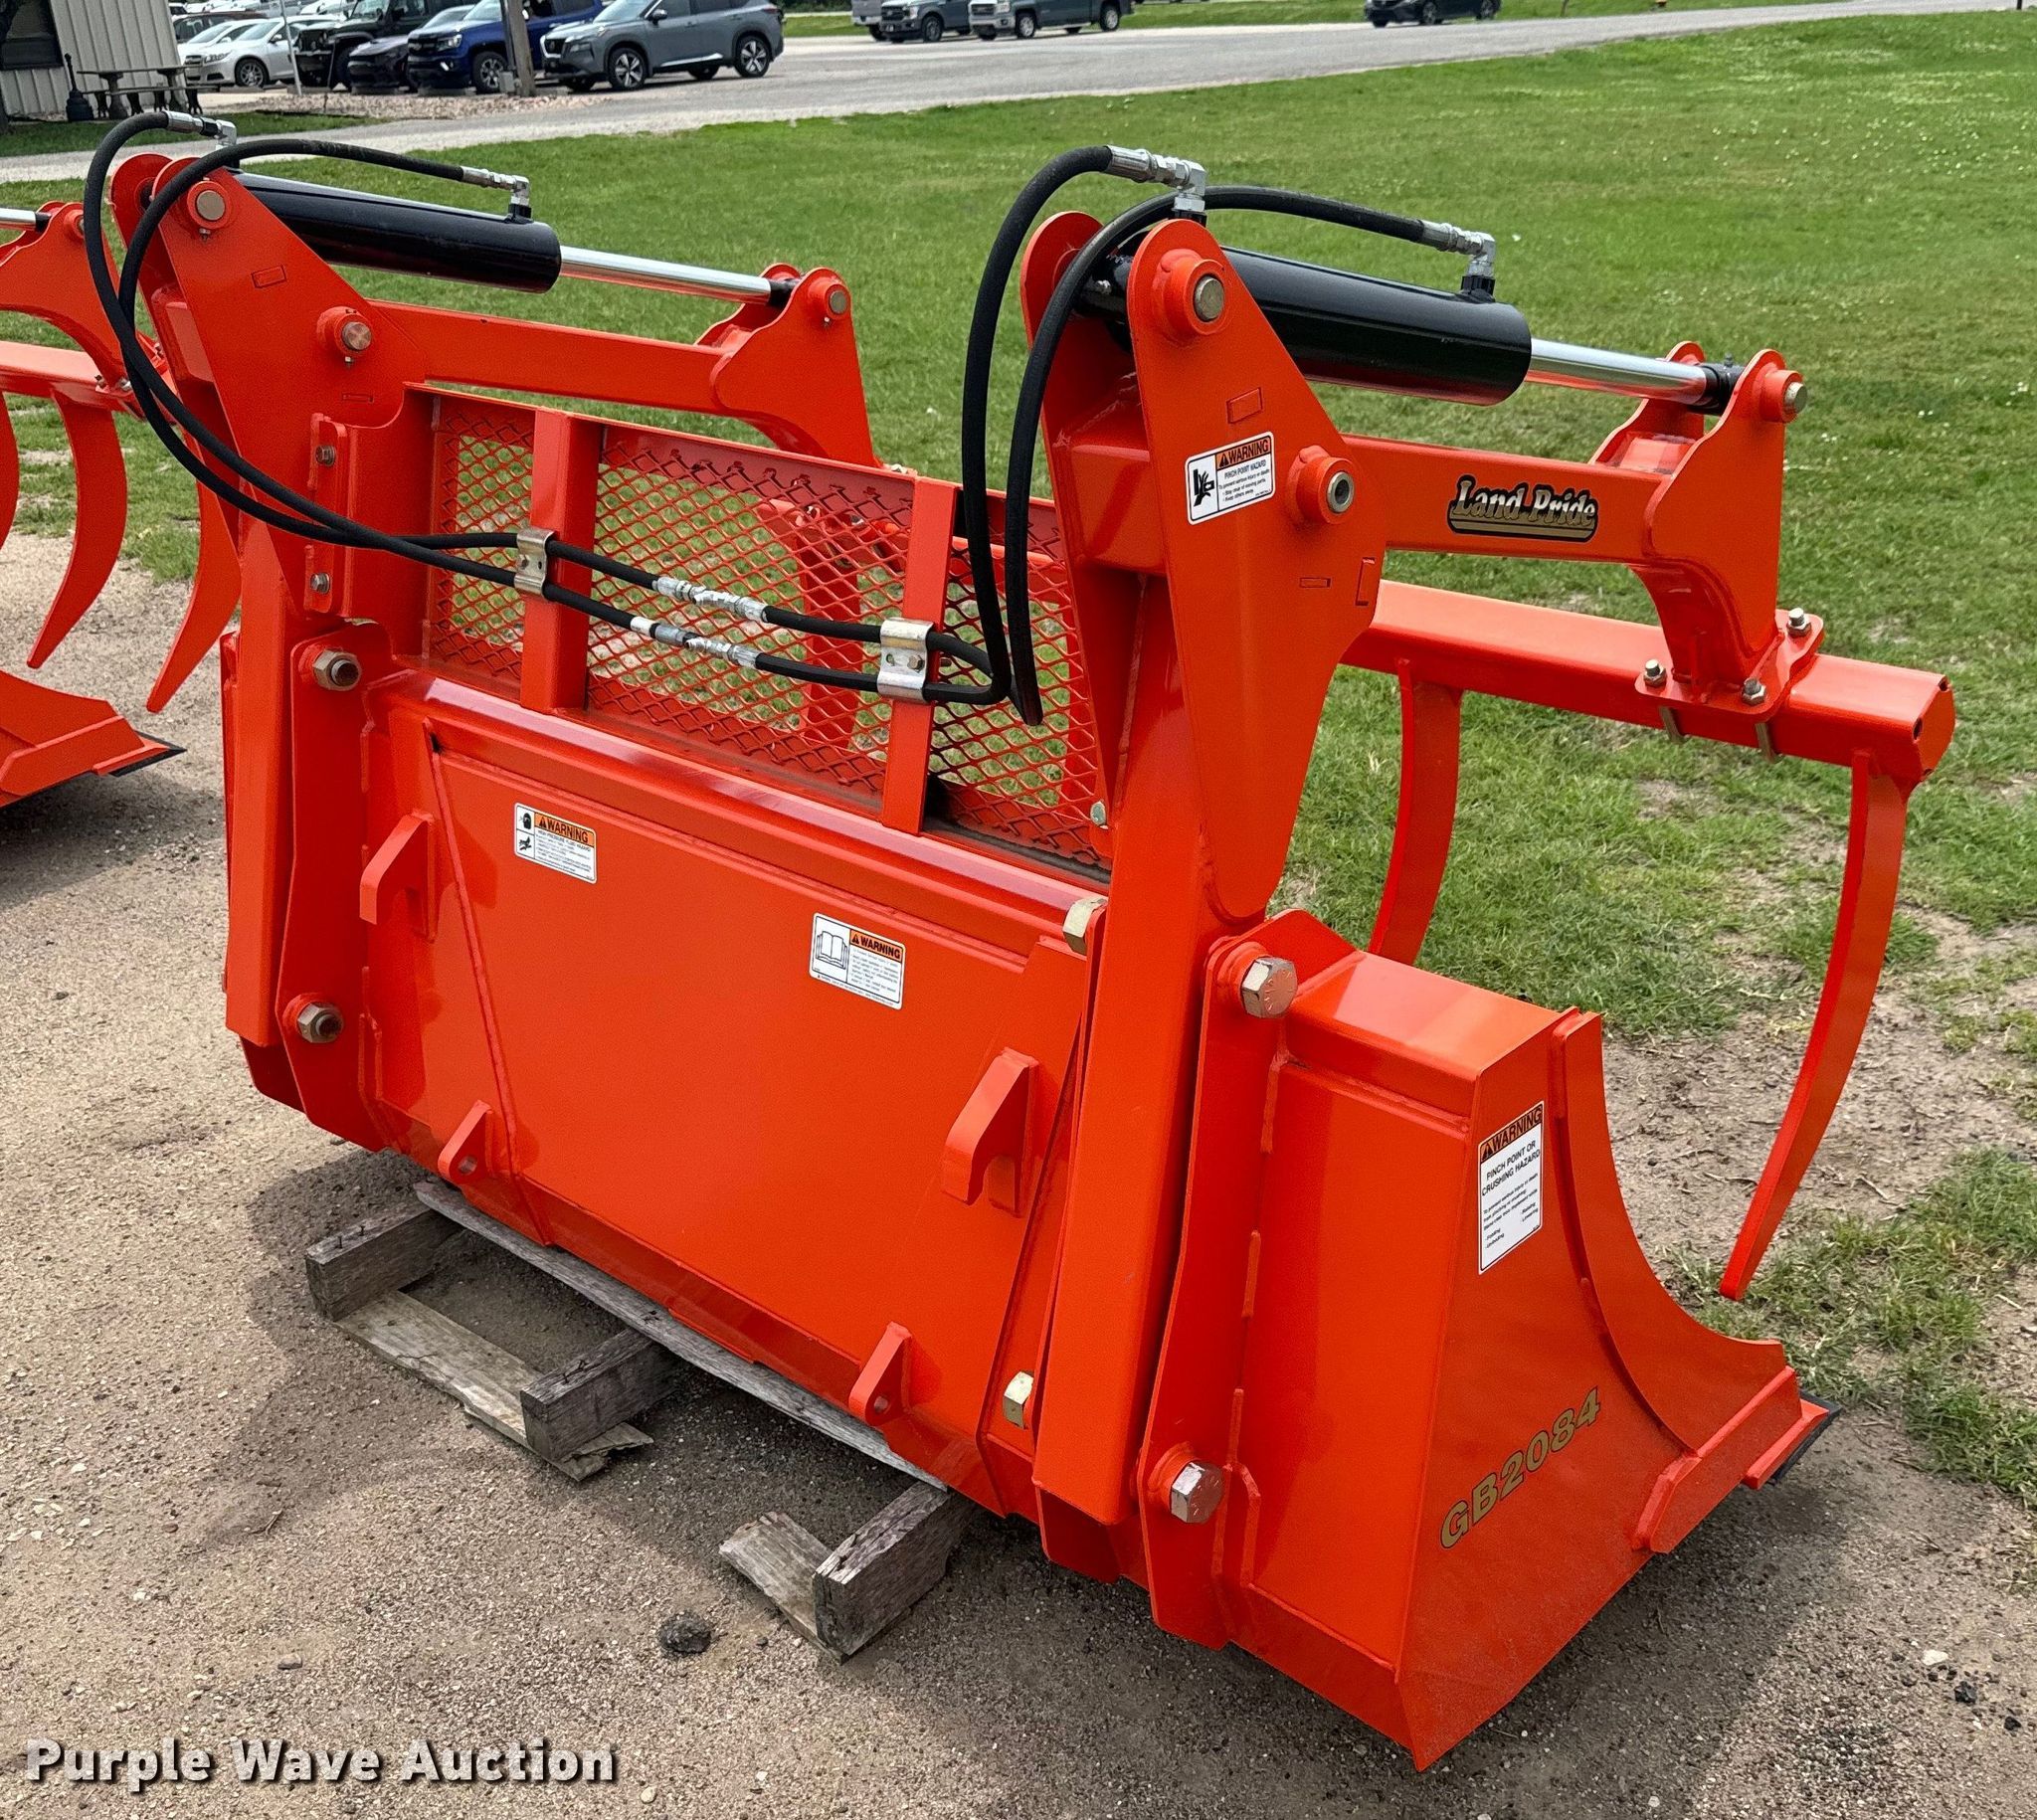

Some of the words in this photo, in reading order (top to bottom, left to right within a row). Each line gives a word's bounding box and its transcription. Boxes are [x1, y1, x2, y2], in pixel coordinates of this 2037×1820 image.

[1228, 440, 1268, 463] WARNING
[1452, 479, 1526, 520] Land
[1528, 488, 1596, 527] Pride
[548, 819, 588, 843] WARNING
[860, 936, 900, 959] WARNING
[1493, 1108, 1542, 1150] WARNING
[1482, 1169, 1513, 1196] CRUSHING
[1516, 1150, 1540, 1173] HAZARD
[1487, 1162, 1505, 1181] PINCH
[1508, 1148, 1525, 1167] POINT
[1527, 1140, 1536, 1153] OR
[1440, 1385, 1601, 1549] GB2084
